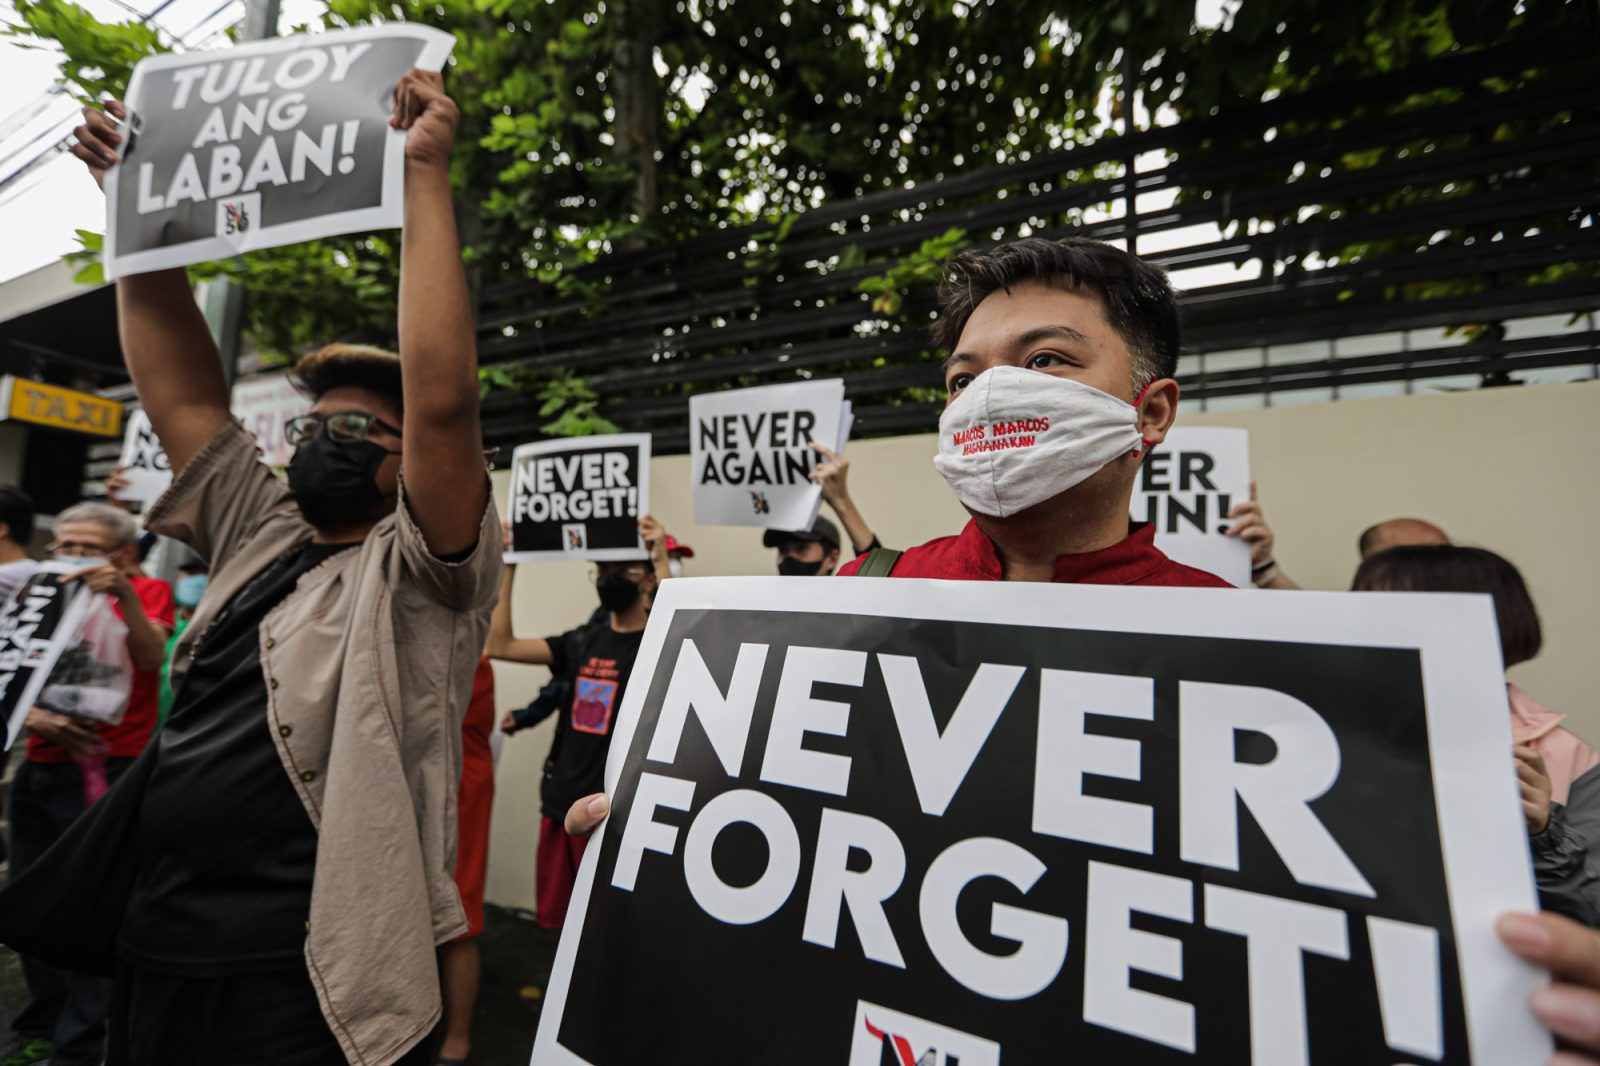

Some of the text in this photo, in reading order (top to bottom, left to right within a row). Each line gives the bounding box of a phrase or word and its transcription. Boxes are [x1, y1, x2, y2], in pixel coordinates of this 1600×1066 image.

[172, 43, 371, 110] TULOY
[193, 94, 308, 149] ANG
[137, 120, 361, 215] LABAN!
[24, 388, 112, 429] TAXI
[699, 410, 816, 451] NEVER
[954, 417, 1050, 446] MARCOS MARCOS
[516, 451, 632, 495] NEVER
[514, 486, 638, 523] FORGET!
[645, 637, 1377, 899] NEVER
[610, 772, 1443, 1066] FORGET!
